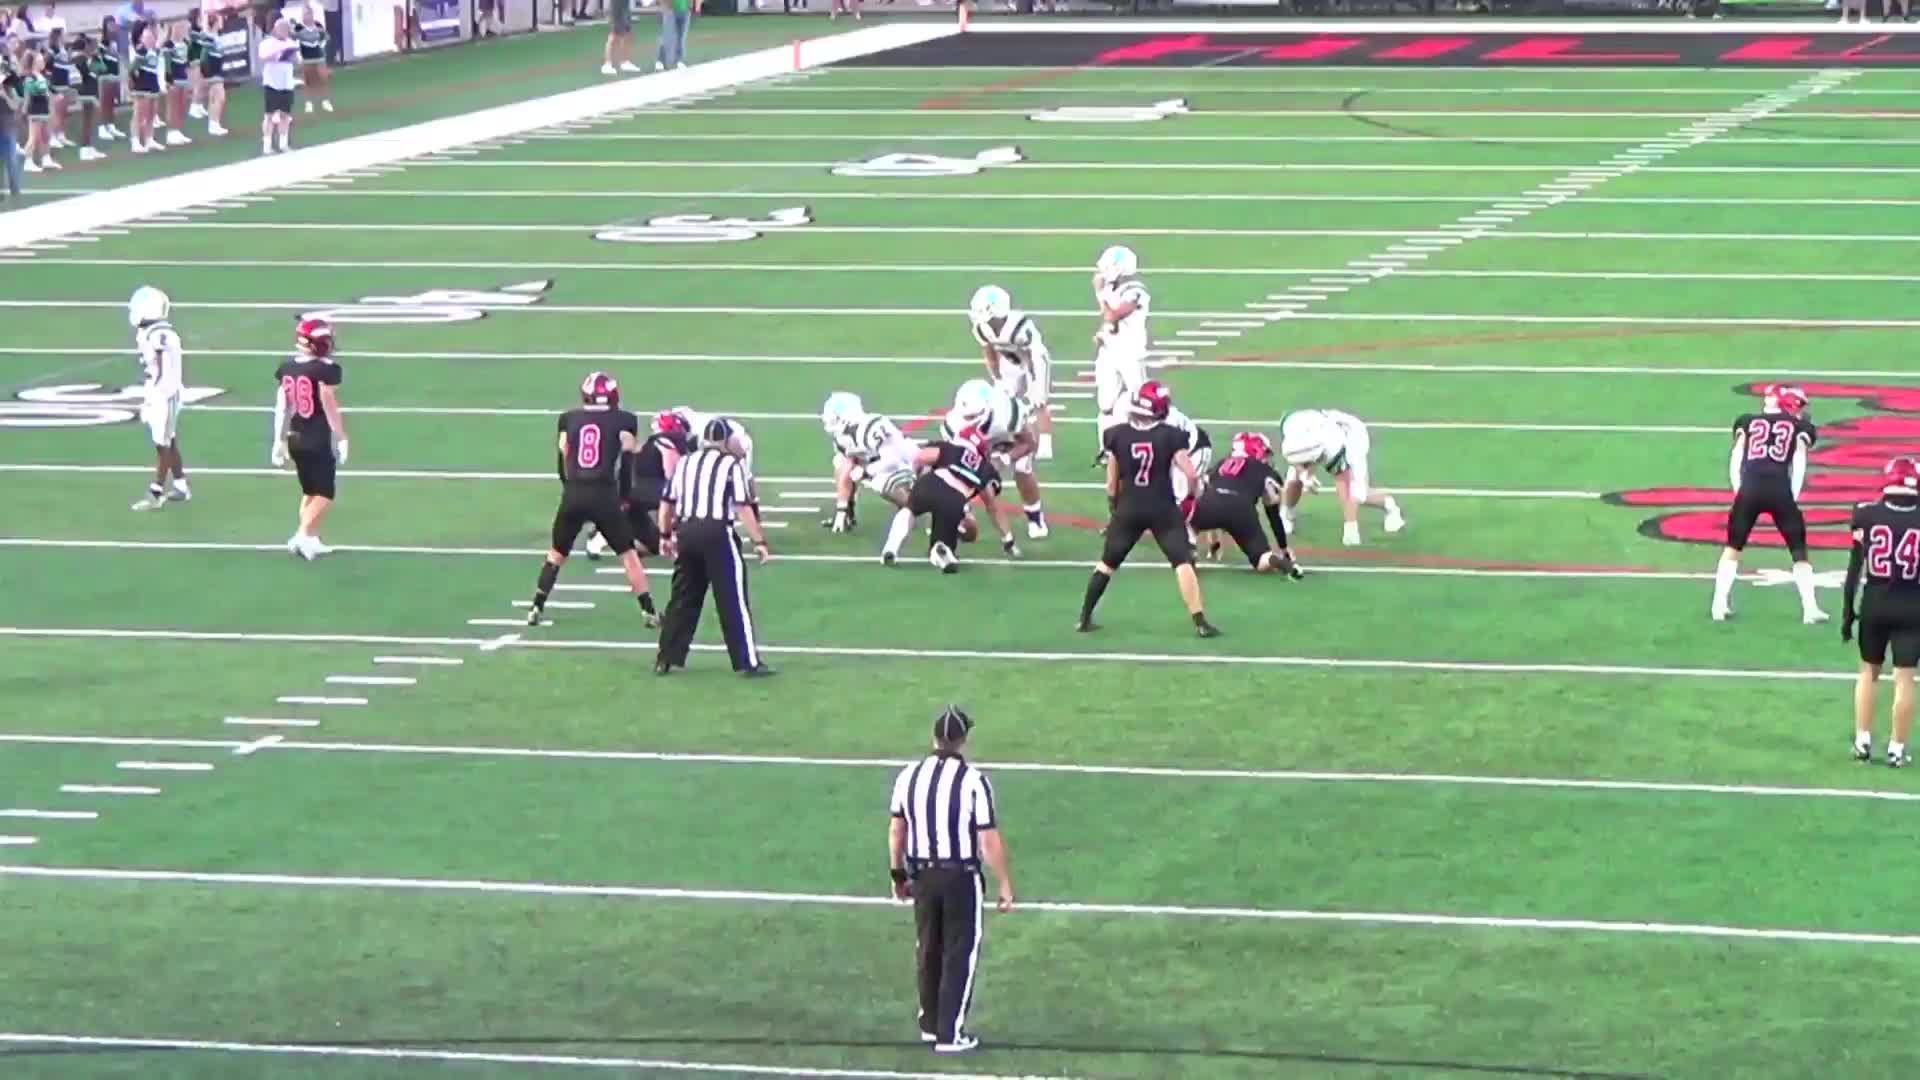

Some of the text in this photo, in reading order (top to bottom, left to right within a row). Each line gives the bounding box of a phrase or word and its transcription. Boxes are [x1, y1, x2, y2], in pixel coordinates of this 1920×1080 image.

[578, 424, 601, 467] 8
[1747, 418, 1794, 461] 23
[1132, 443, 1154, 486] 7
[1868, 525, 1920, 579] 24
